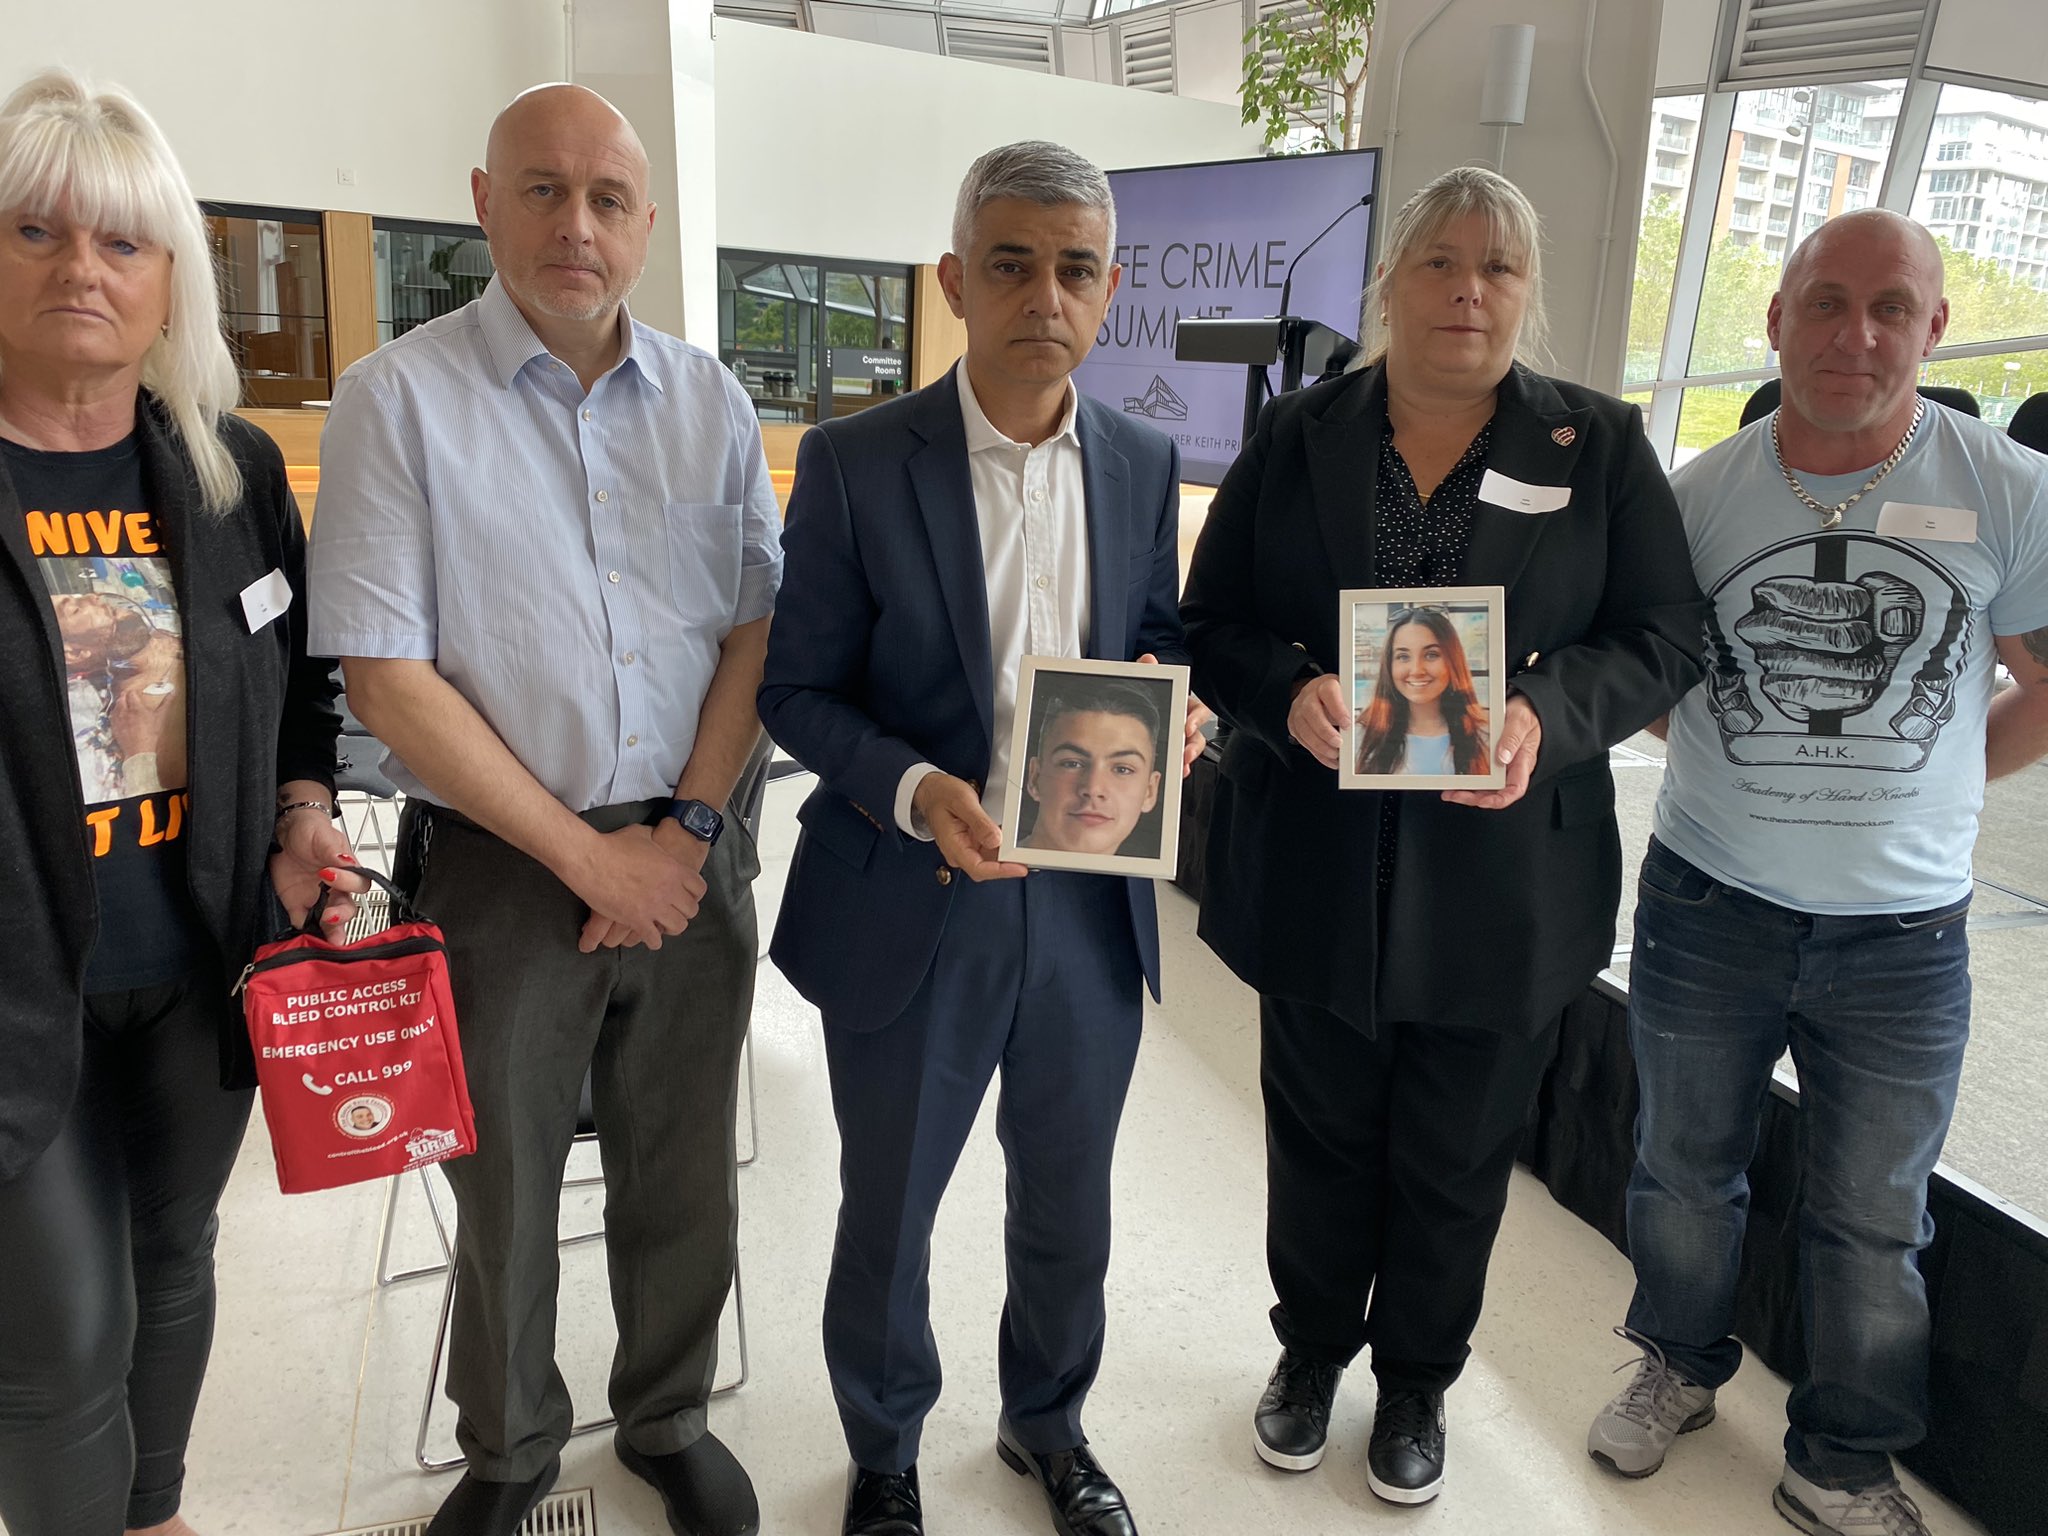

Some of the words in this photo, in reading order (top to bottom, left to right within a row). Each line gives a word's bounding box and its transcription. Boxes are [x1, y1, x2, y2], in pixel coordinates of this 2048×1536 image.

[1116, 244, 1150, 288] FE
[1161, 241, 1287, 289] CRIME
[1096, 304, 1233, 349] SUMT
[862, 355, 902, 366] Committee
[875, 366, 896, 375] Room
[896, 367, 902, 375] 6
[1170, 433, 1192, 446] BER
[1195, 435, 1222, 449] KEITH
[25, 509, 167, 555] NIVE
[1795, 744, 1855, 758] A.H.K.
[1731, 777, 1796, 804] Academy
[1799, 790, 1818, 804] of
[1815, 787, 1866, 802] Hard
[1868, 786, 1920, 802] Knocks
[139, 792, 189, 847] LI
[1749, 812, 1895, 828] www.theacademyofhardknocks.com
[287, 989, 347, 1009] PUBLIC
[352, 978, 407, 1000] ACCESS
[272, 1009, 321, 1026] BLEED
[324, 997, 397, 1019] CONTROL
[399, 991, 422, 1007] KIT
[262, 1036, 360, 1059] EMERGENCY
[364, 1029, 397, 1046] USE
[400, 1015, 436, 1040] ONLY
[334, 1068, 378, 1086] CALL
[381, 1060, 413, 1079] 999
